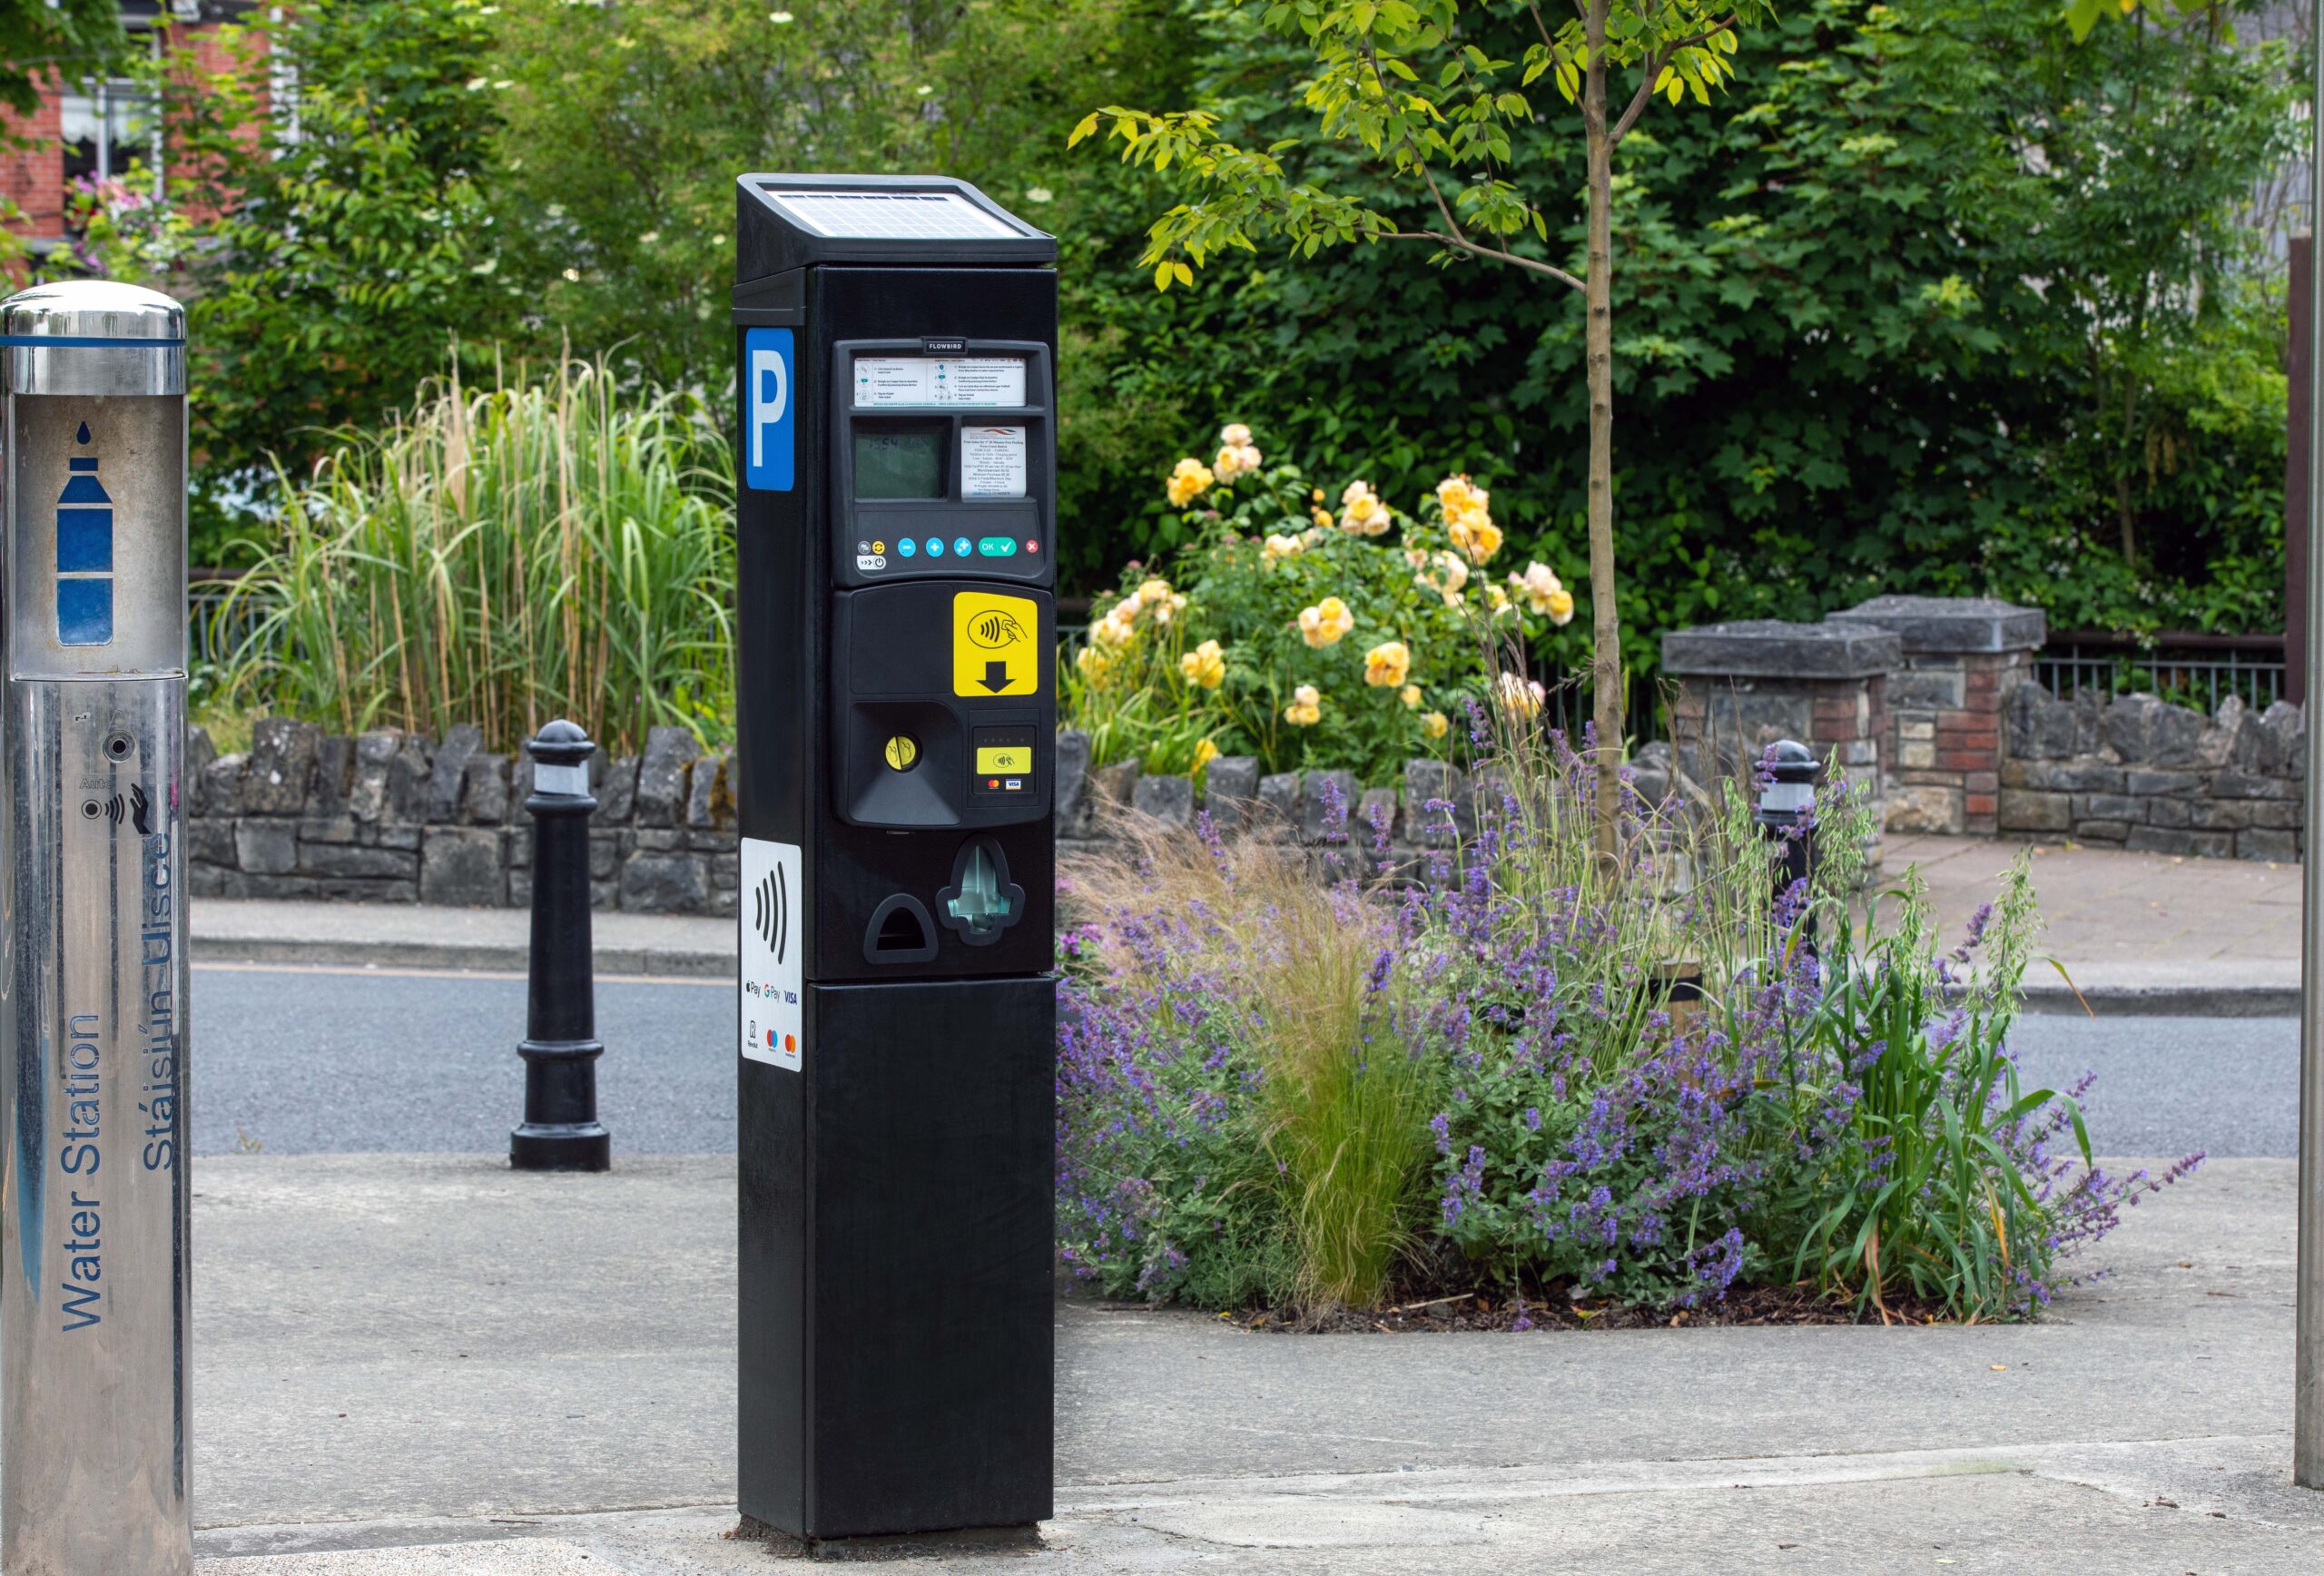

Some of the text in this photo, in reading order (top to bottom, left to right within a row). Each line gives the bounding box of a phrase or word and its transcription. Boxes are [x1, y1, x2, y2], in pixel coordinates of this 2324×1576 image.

[753, 350, 787, 467] P
[981, 543, 995, 551] OK
[138, 832, 172, 1171] Stáisiún Uisce
[751, 981, 761, 999] Pay
[784, 990, 798, 1006] VISA
[60, 1014, 102, 1333] Water Station
